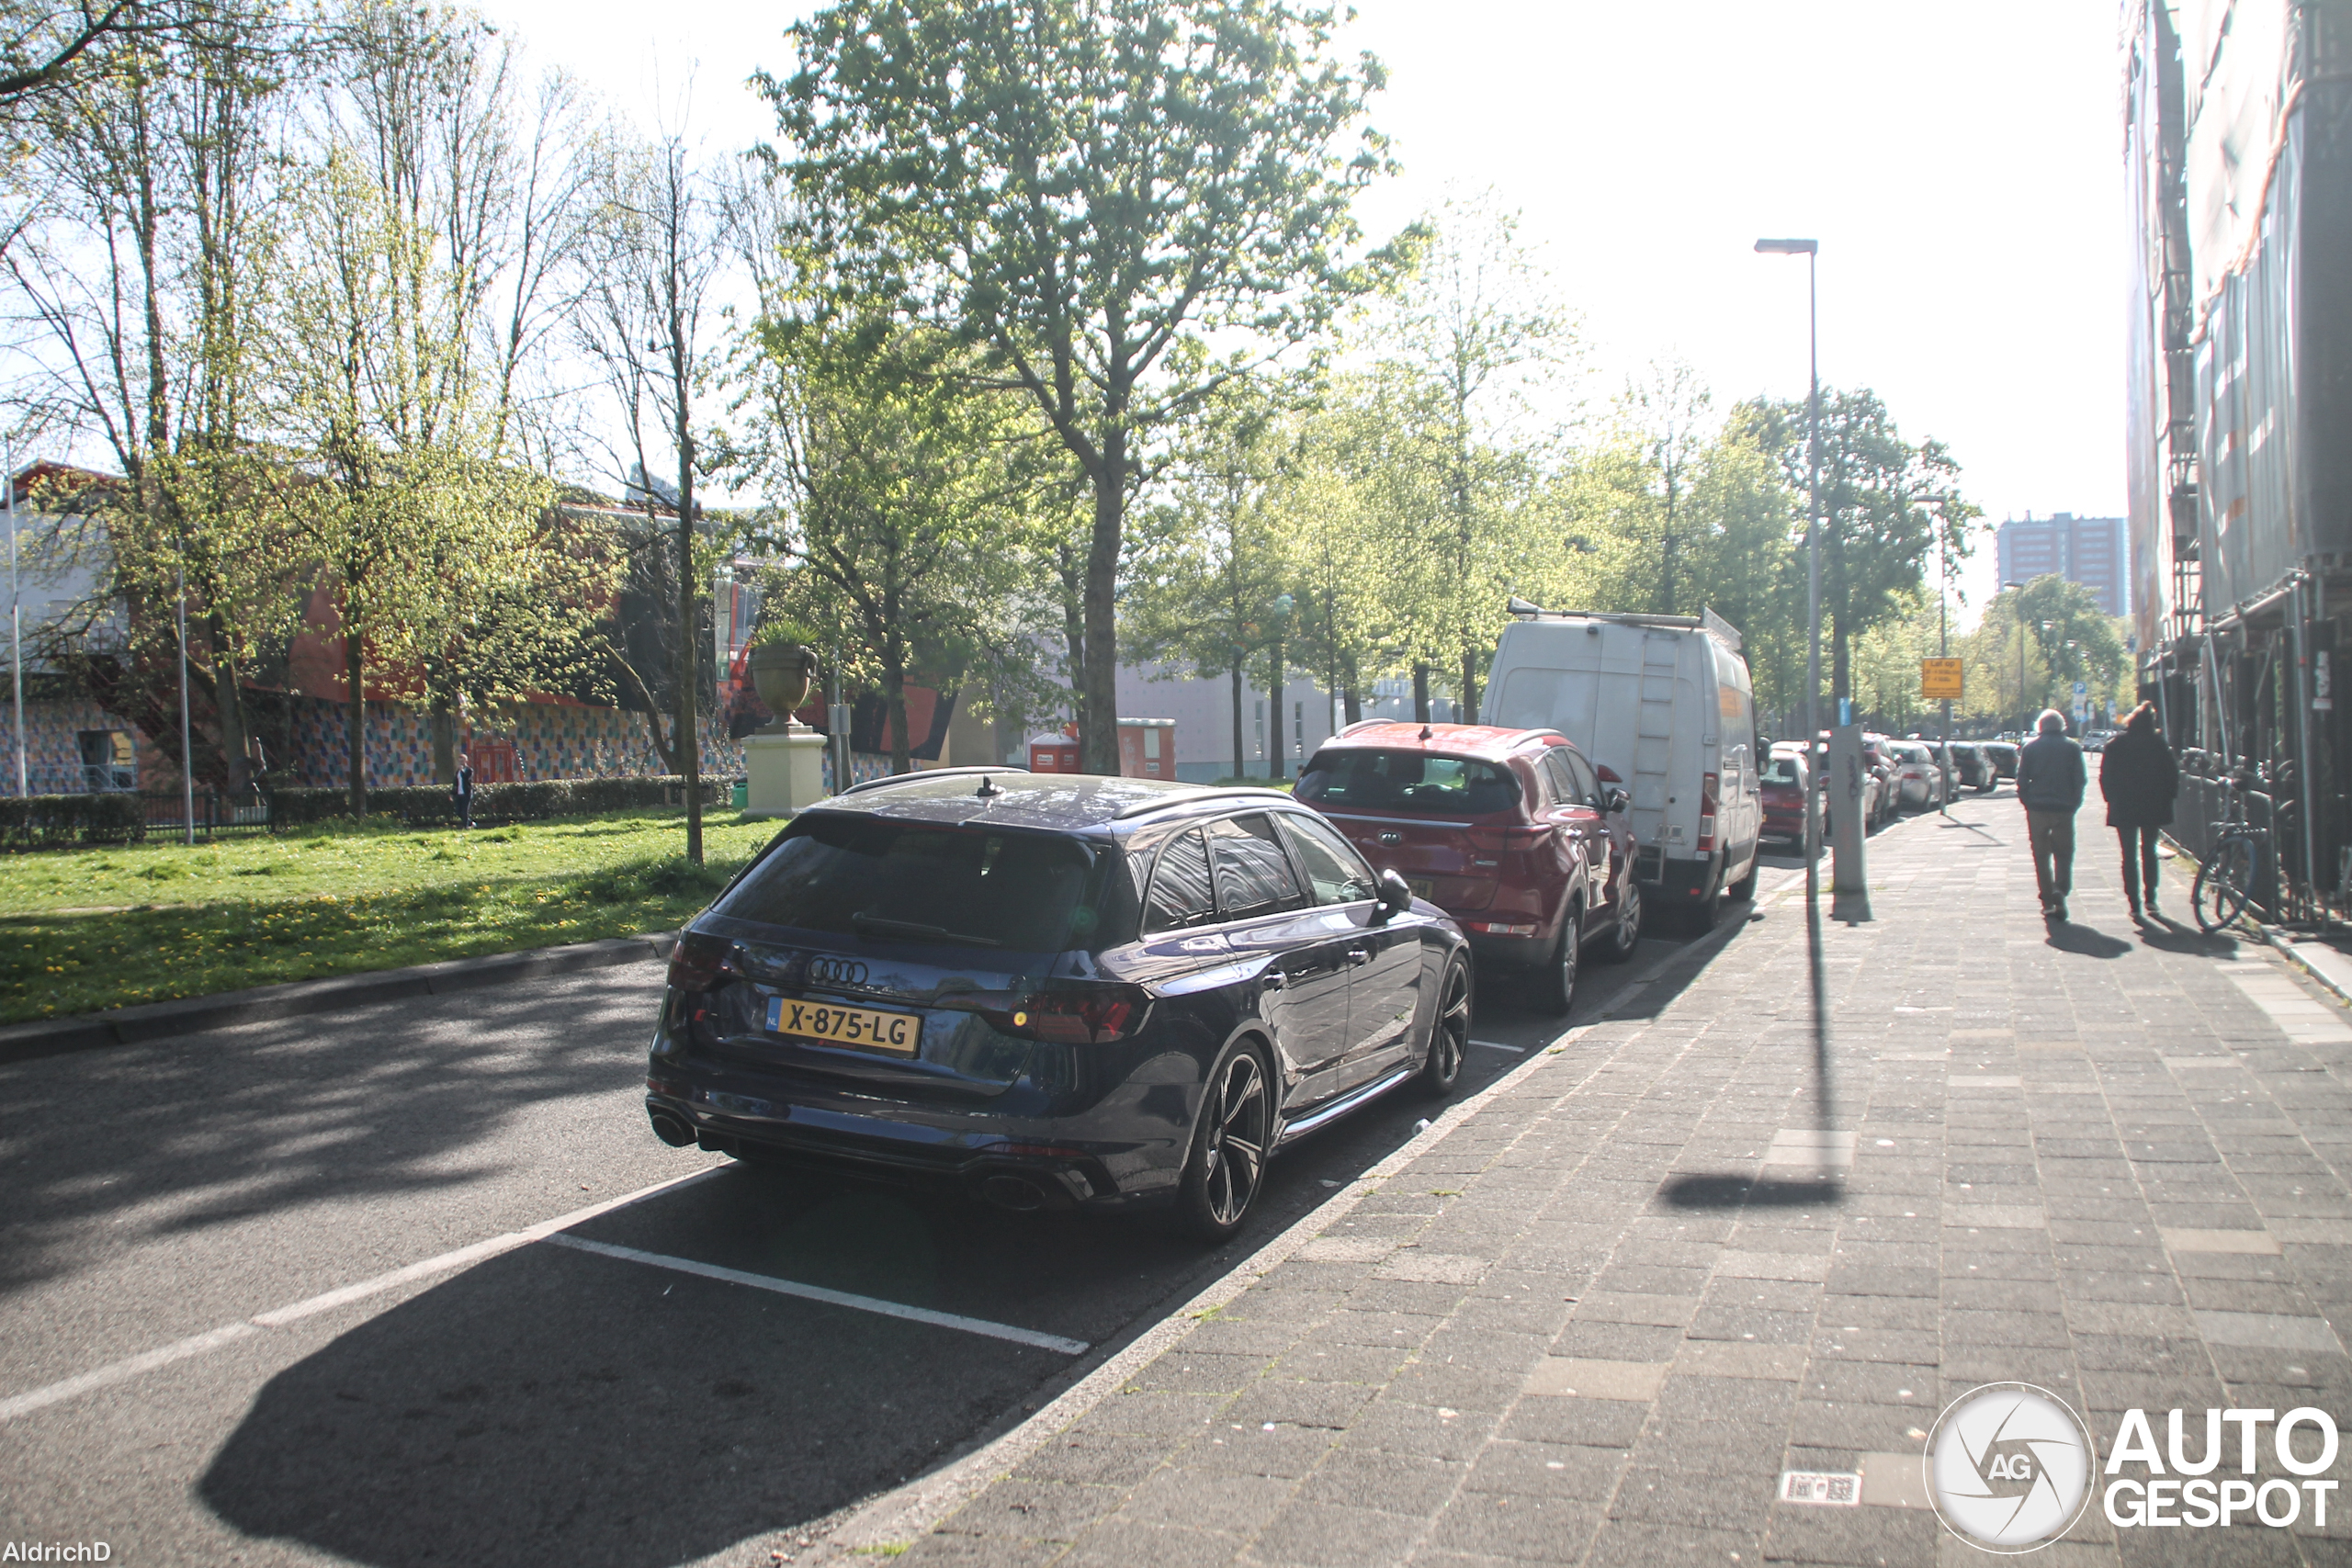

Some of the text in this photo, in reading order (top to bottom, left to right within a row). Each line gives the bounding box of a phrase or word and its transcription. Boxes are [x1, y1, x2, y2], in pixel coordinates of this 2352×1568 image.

[2076, 682, 2085, 693] P
[767, 1017, 777, 1026] NL
[787, 1004, 906, 1045] X-875-LG
